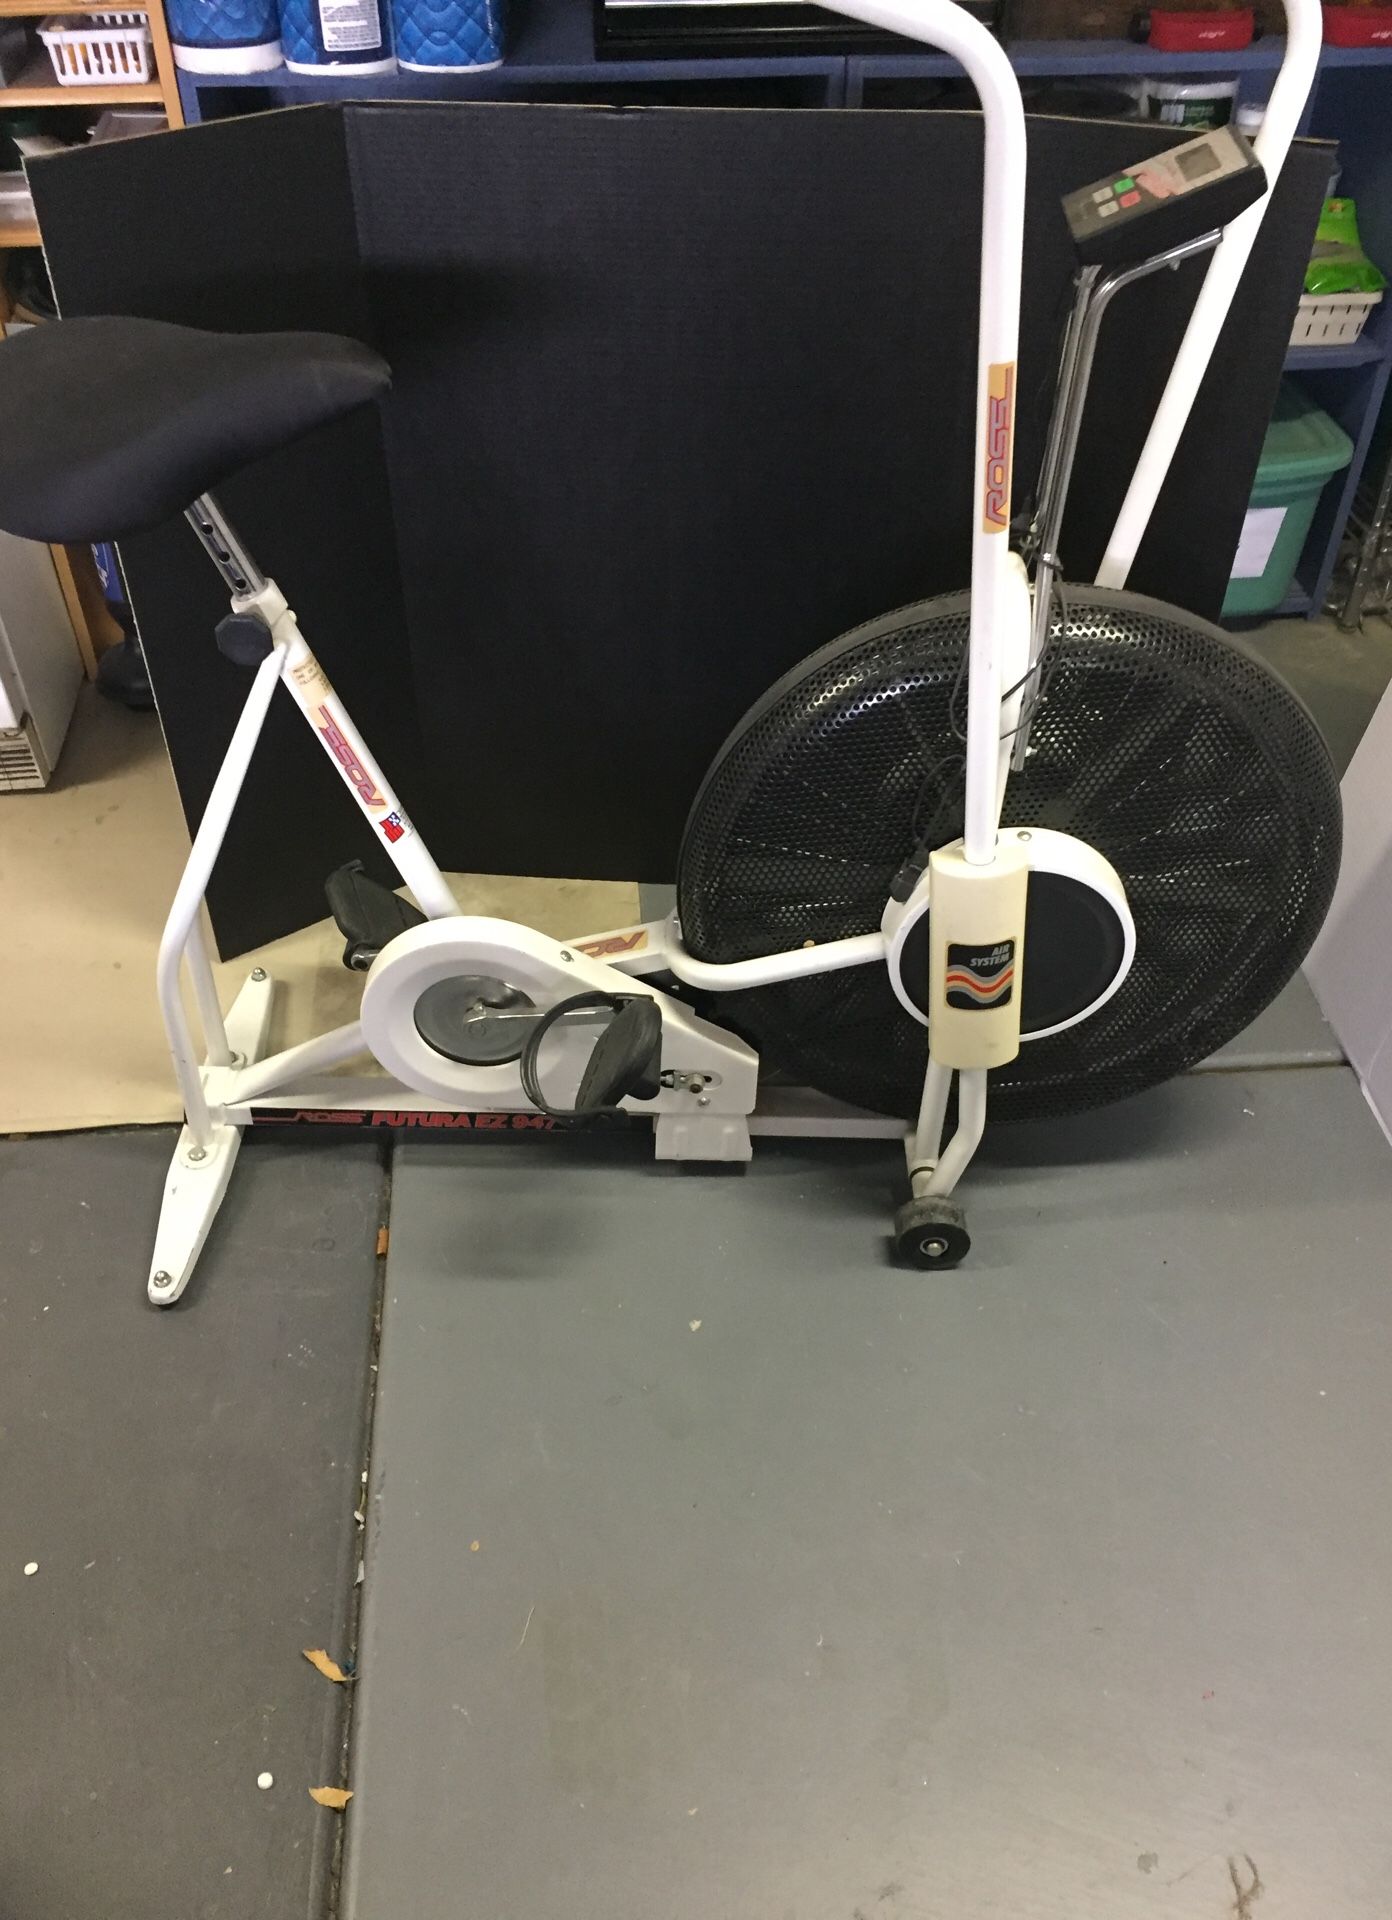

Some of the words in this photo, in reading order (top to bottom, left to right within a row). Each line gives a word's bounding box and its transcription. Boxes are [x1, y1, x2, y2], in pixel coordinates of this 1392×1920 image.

[986, 368, 1014, 525] ROSS
[319, 704, 386, 806] ROSS
[573, 931, 645, 958] RO
[991, 944, 1010, 956] AIR
[969, 953, 1010, 967] SYSTEM
[294, 1111, 366, 1123] ROSS
[371, 1111, 472, 1128] FUTURA
[475, 1114, 508, 1129] EZ
